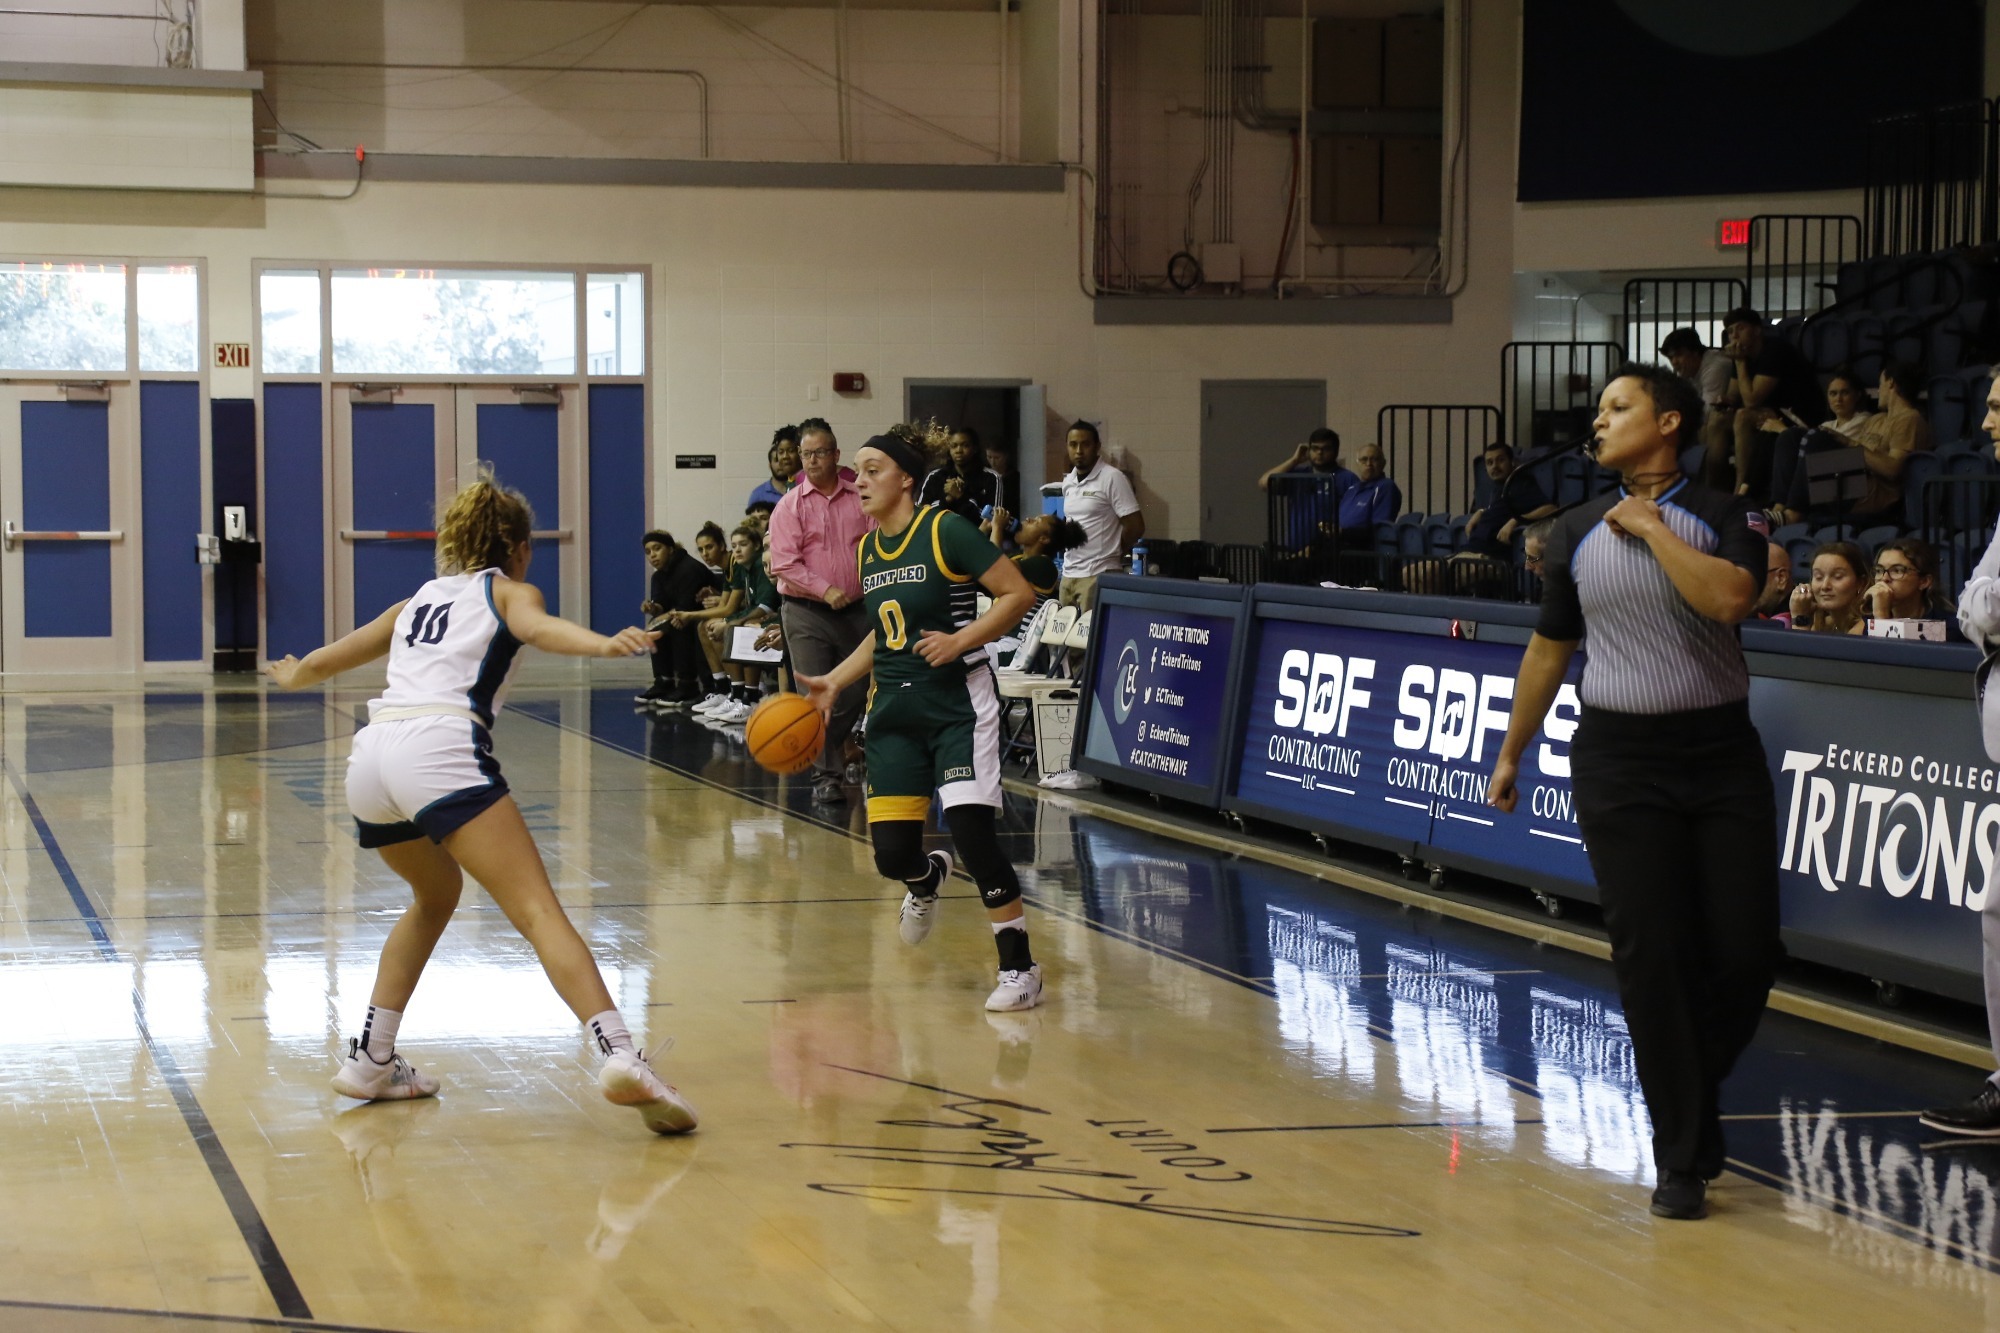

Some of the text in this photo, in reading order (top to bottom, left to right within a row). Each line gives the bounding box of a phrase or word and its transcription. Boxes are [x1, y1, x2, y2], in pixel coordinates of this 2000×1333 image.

[1721, 220, 1750, 245] EXIT
[214, 343, 249, 367] EXIT
[863, 564, 926, 594] SAINT LEO
[405, 601, 455, 648] 10
[878, 599, 907, 651] 0
[1149, 622, 1210, 645] FOLLOW THE TRITONS
[1161, 650, 1202, 672] EckerdTritons
[1125, 663, 1140, 694] EC
[1274, 649, 1376, 738] SDF
[1155, 687, 1184, 707] ECTritons
[1393, 664, 1515, 763] SDF
[1149, 723, 1190, 747] EckerdTritons
[1129, 747, 1188, 776] #CATCHTHEWAVE
[1268, 734, 1361, 778] CONTRACTING
[1826, 743, 1904, 778] ECKERD
[1301, 773, 1316, 790] LLC
[1387, 757, 1494, 806] CONTRACTIN
[1429, 800, 1447, 820] LLC
[1780, 749, 2000, 912] TRITONS
[1085, 1119, 1252, 1182] COURT
